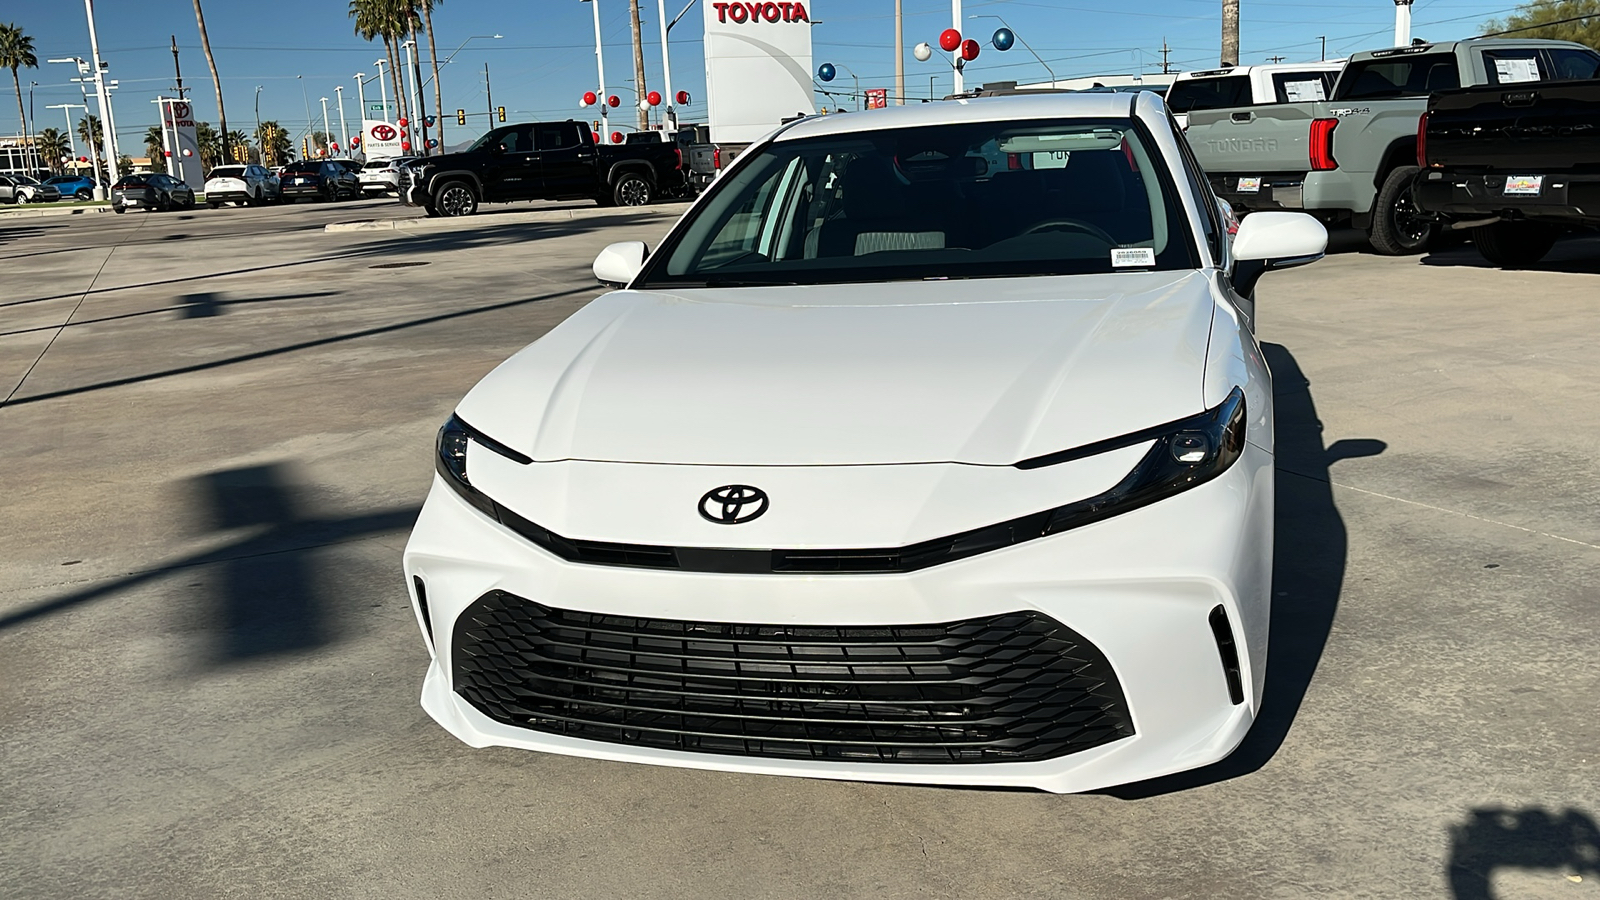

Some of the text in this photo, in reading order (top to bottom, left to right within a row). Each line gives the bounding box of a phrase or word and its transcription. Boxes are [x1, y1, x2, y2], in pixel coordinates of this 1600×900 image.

[713, 2, 810, 24] TOYOTA
[1329, 108, 1353, 117] TRD
[166, 120, 195, 128] TYOTA
[1207, 138, 1278, 153] TUNDRA
